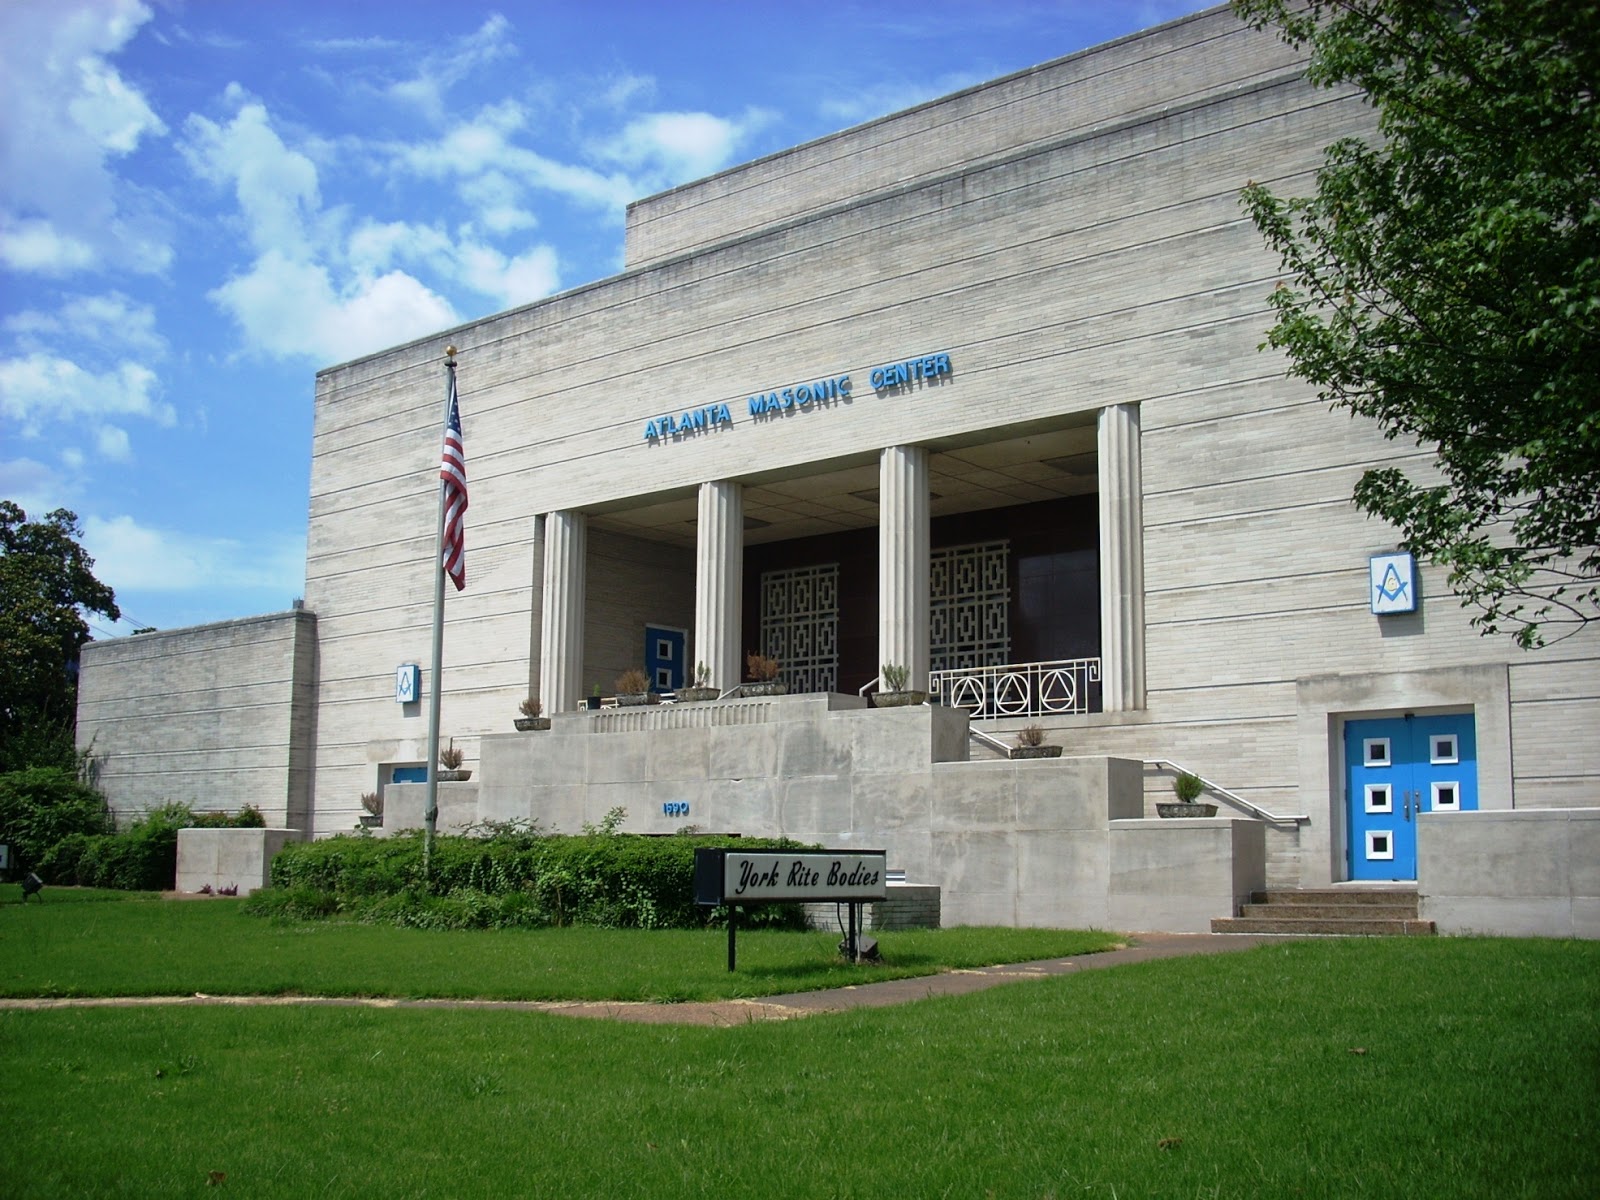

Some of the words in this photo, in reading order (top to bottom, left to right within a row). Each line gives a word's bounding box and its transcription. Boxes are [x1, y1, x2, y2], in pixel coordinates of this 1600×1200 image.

[643, 403, 731, 440] ATLANTA
[747, 375, 851, 416] MASONIC
[869, 353, 950, 390] CENTER
[735, 860, 779, 895] York
[786, 860, 819, 887] Rite
[826, 861, 879, 887] Bodies
